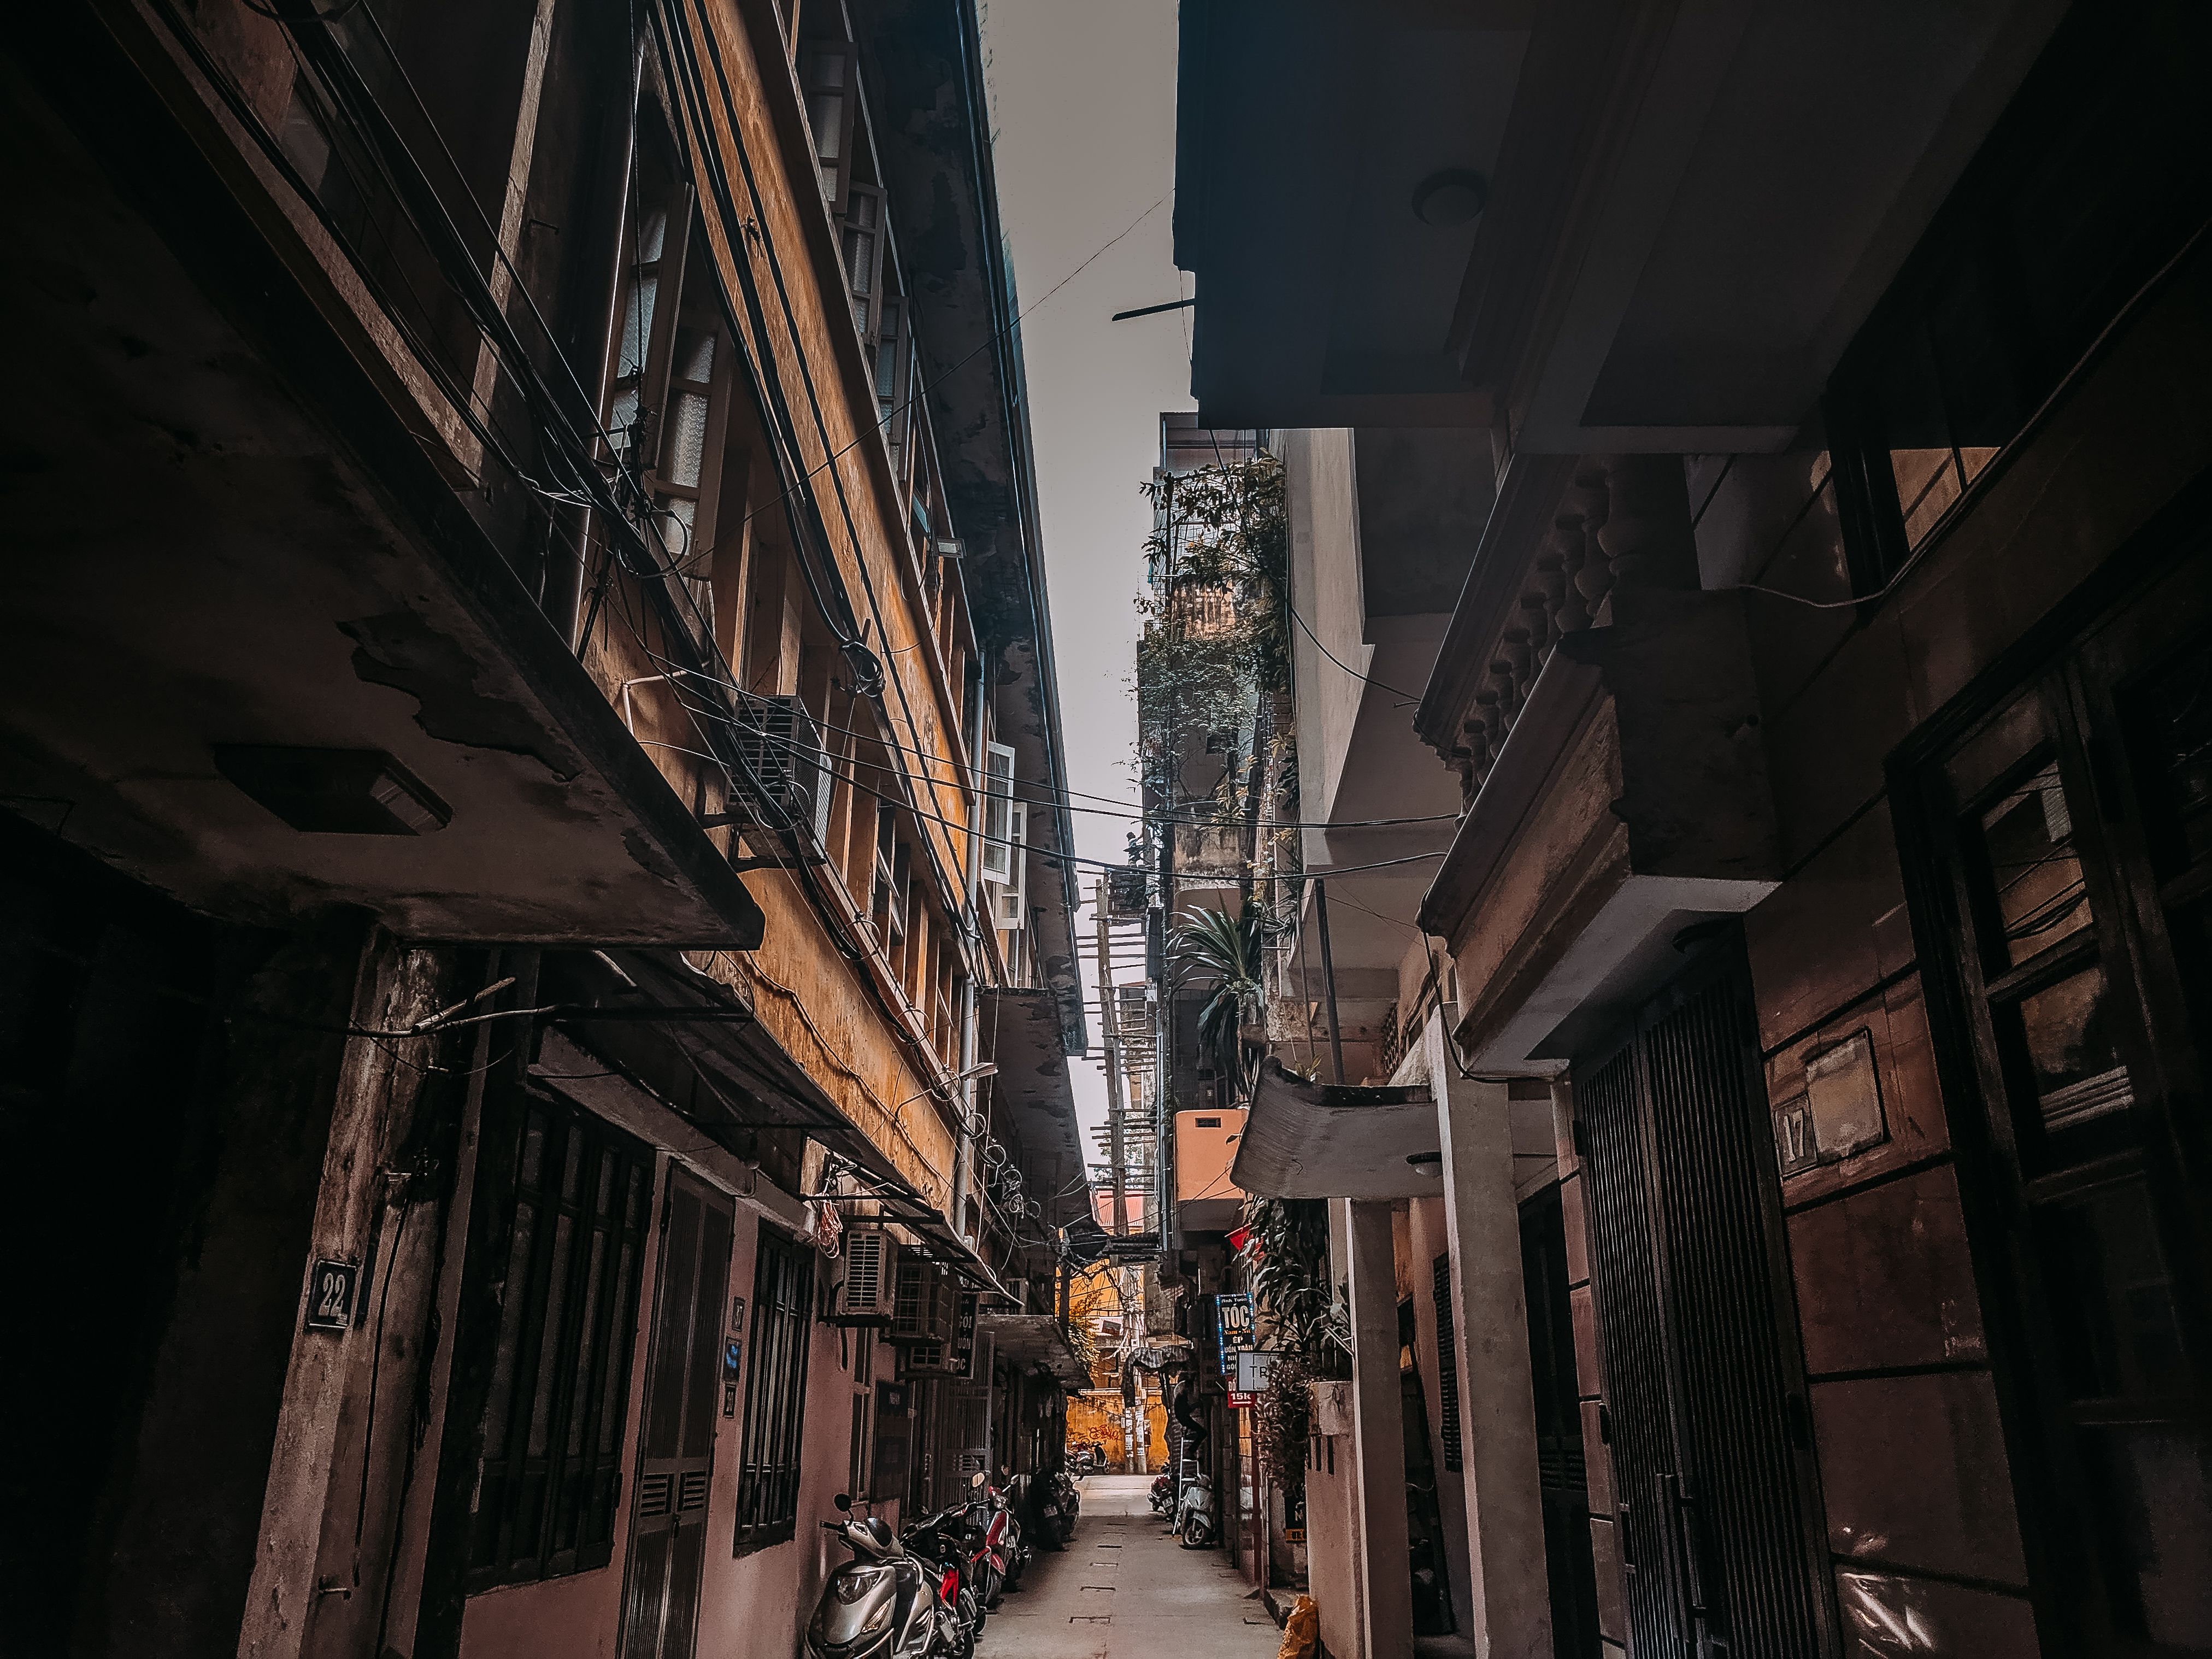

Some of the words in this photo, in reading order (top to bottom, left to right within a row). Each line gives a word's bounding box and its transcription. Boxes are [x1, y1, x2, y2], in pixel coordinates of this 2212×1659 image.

[1782, 1108, 1805, 1163] 17
[318, 1273, 346, 1317] 22
[1221, 1303, 1250, 1328] TÓC
